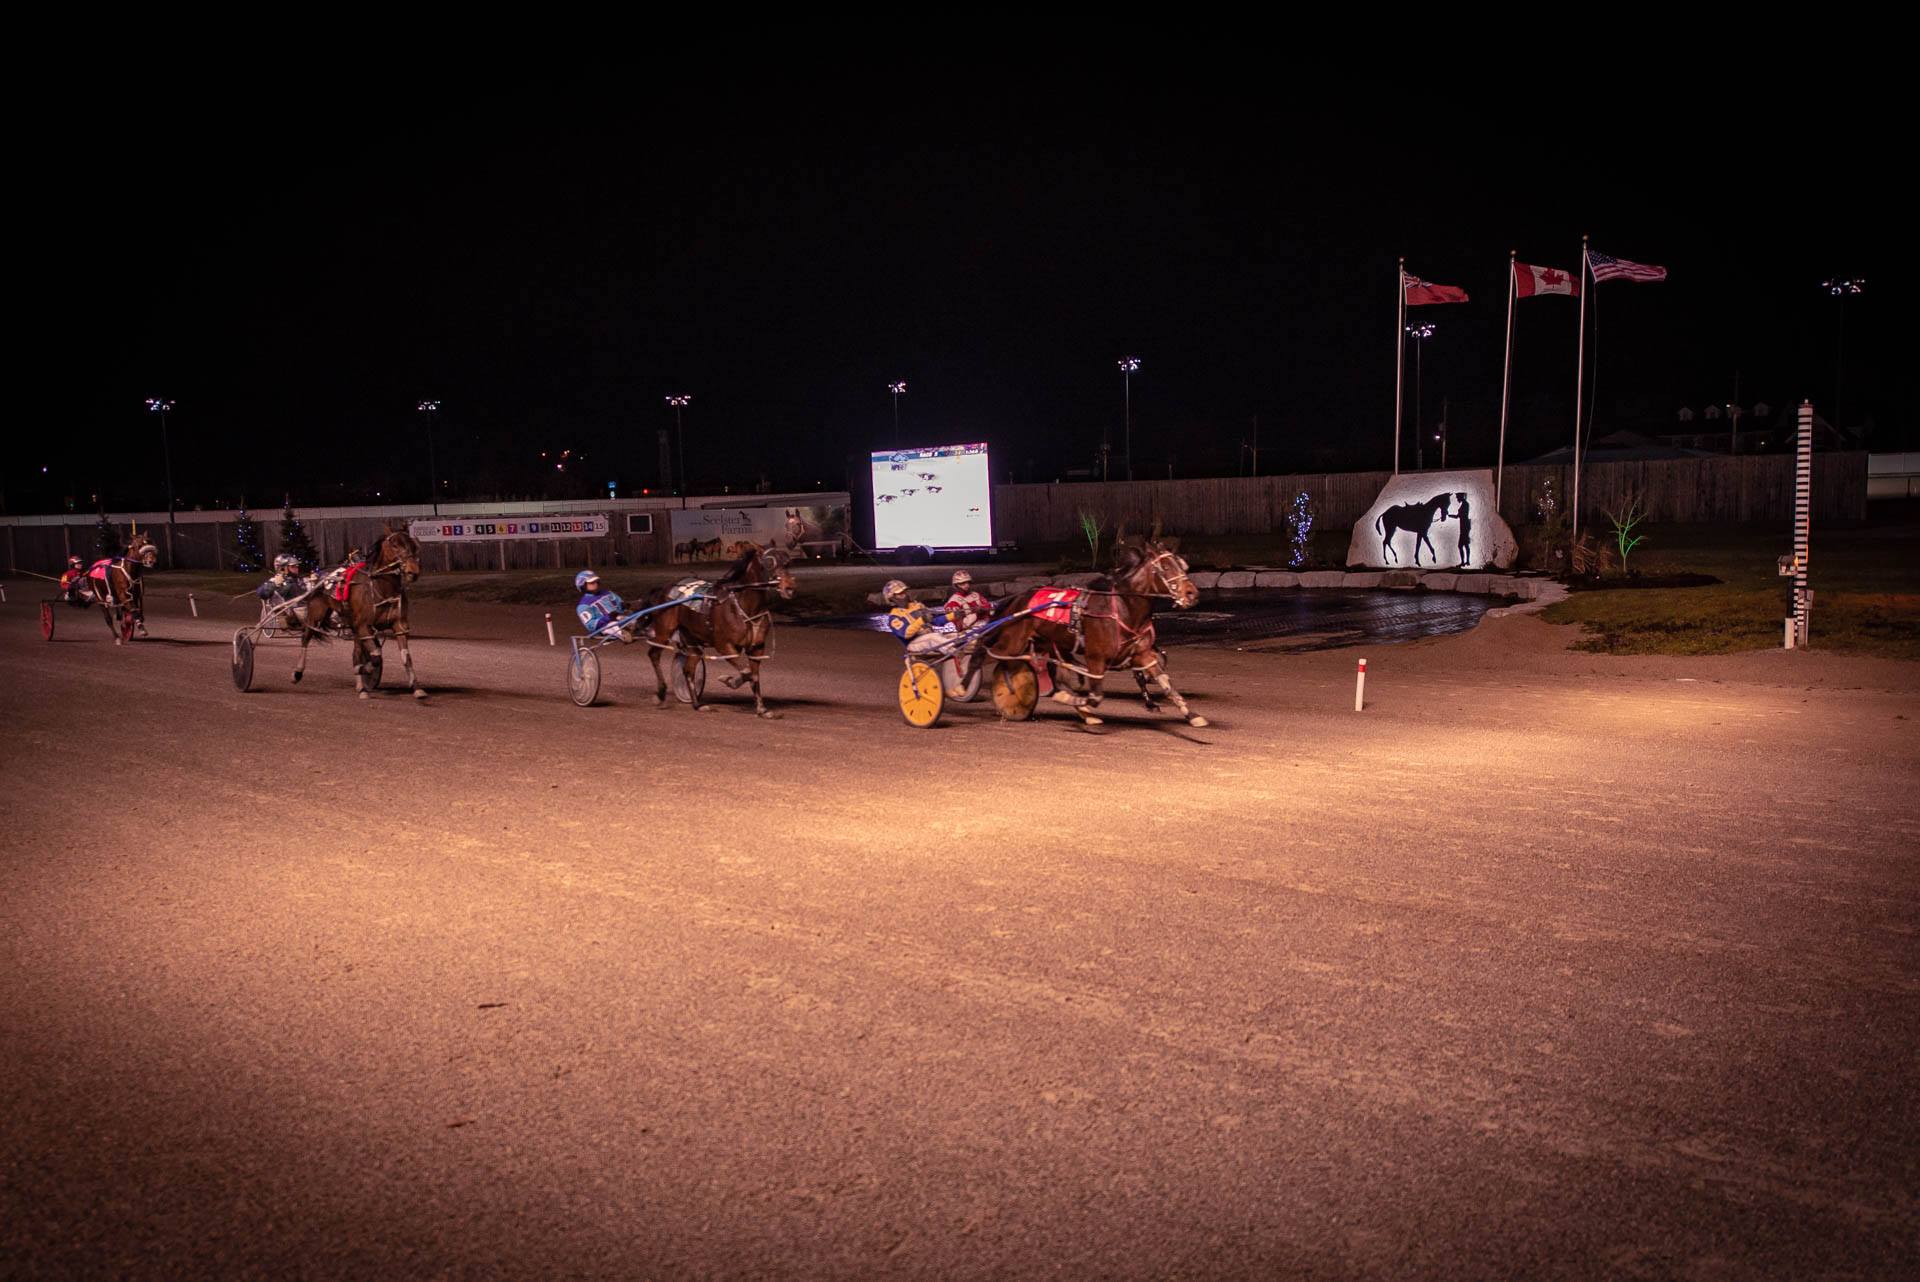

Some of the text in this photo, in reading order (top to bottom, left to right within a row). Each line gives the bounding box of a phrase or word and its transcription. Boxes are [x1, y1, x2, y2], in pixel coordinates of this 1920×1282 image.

[454, 526, 462, 535] 2
[465, 526, 472, 534] 3
[476, 525, 483, 534] 4
[487, 525, 494, 534] 5
[509, 524, 516, 533] 7
[531, 524, 538, 532] 9
[551, 523, 560, 532] 11
[561, 523, 570, 532] 12
[573, 522, 582, 531] 13
[584, 522, 593, 531] 14
[594, 522, 603, 531] 15
[1046, 591, 1067, 618] 7
